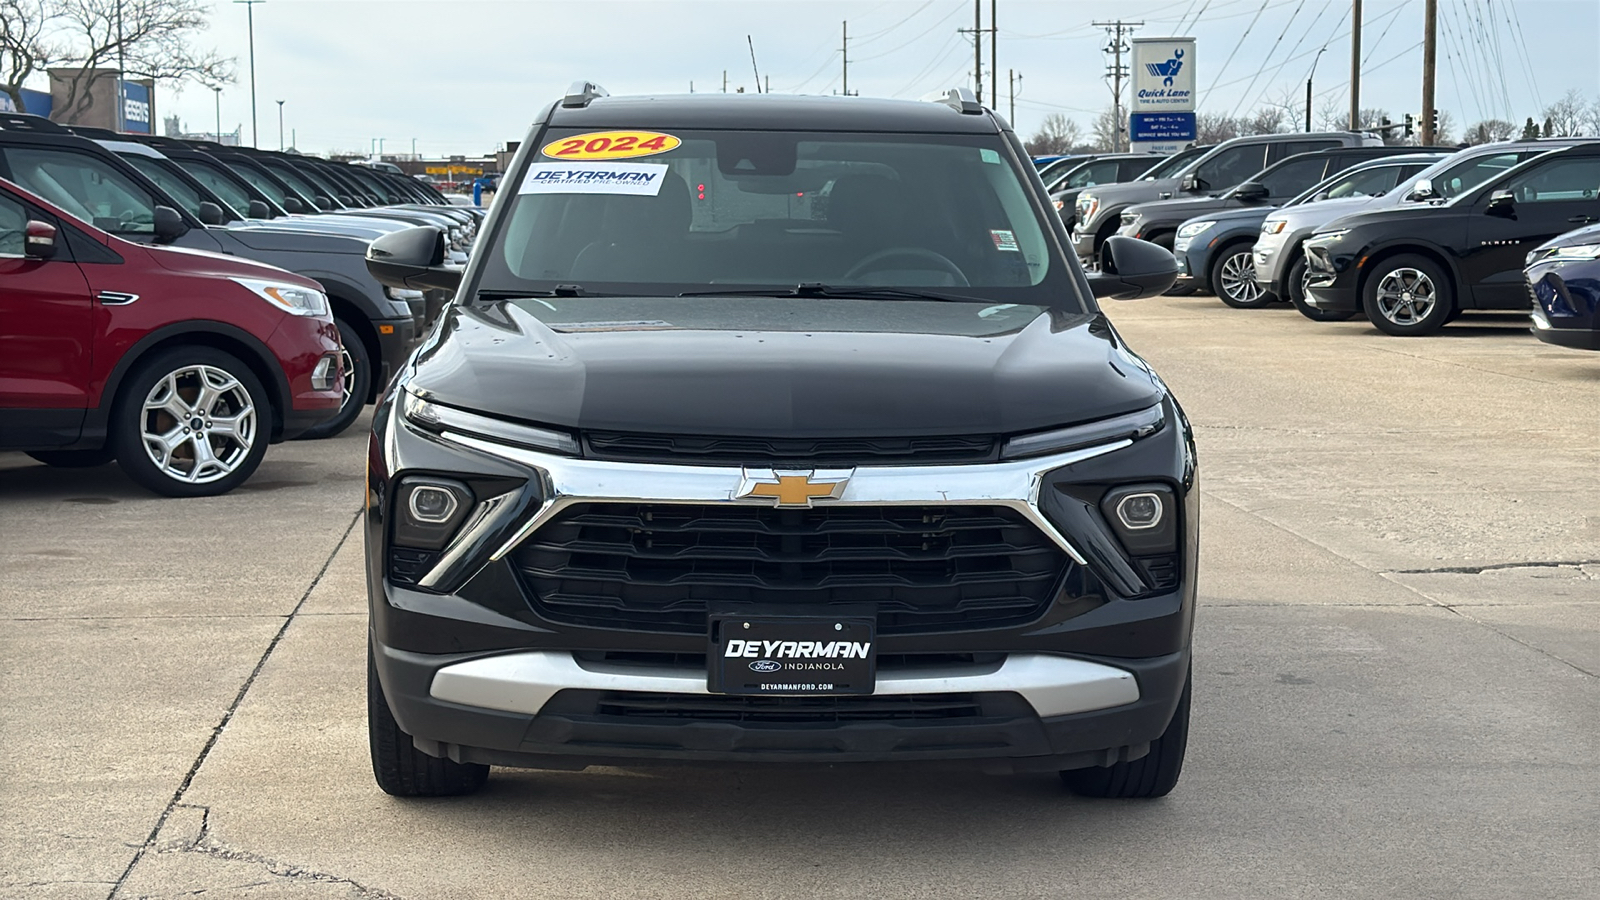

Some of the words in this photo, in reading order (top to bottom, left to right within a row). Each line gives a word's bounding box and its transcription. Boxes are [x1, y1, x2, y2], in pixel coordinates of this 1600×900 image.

[1138, 89, 1165, 98] Quick
[1167, 89, 1190, 97] Lane
[555, 136, 667, 156] 2024
[533, 170, 657, 182] DEYARMAN
[724, 640, 871, 659] DEYARMAN
[754, 662, 775, 670] Ford
